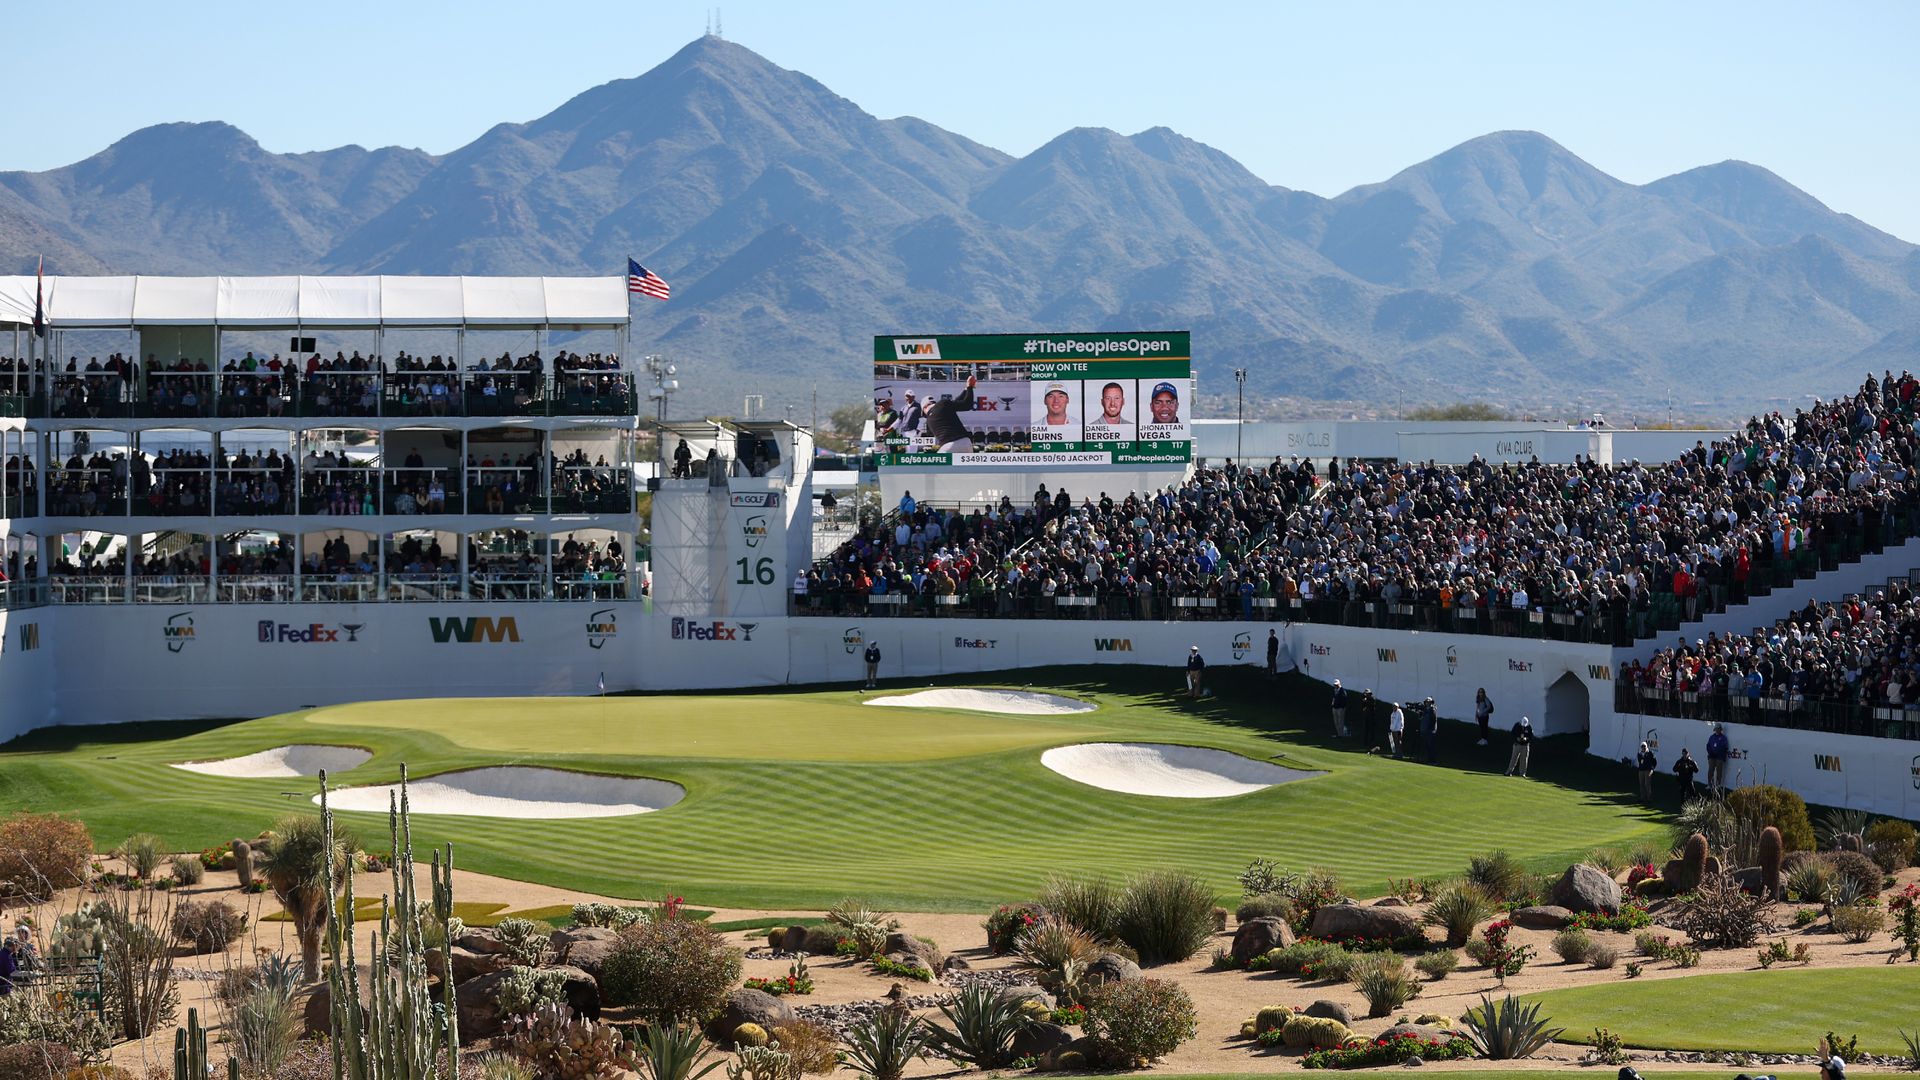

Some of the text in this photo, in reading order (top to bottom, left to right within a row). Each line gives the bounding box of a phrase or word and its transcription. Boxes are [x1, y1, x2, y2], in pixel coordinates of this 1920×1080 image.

[900, 343, 934, 354] WM
[1023, 338, 1171, 356] #ThePeoplesOpen
[1031, 362, 1088, 372] NOW ON TEE
[1032, 433, 1063, 441] BURNS
[1086, 432, 1121, 440] BERGER
[1140, 431, 1171, 440] VEGAS
[1496, 440, 1533, 456] KIVA CLUB
[900, 456, 922, 464] 50/50
[960, 454, 1104, 463] $34912 GUARANTEED 50/50 JACKPOT
[1117, 454, 1185, 462] #ThePeoplesOpen
[744, 495, 764, 504] GOLF
[743, 526, 767, 535] WM
[736, 557, 775, 585] 16
[163, 626, 196, 637] WM
[278, 623, 338, 643] FedEx
[428, 616, 521, 643] WM
[586, 623, 617, 633] WM
[687, 621, 737, 641] FedEx
[963, 638, 988, 648] FedEx
[1094, 638, 1133, 651] WM
[1231, 641, 1251, 649] WM
[1376, 647, 1397, 663] WM
[1588, 664, 1611, 680] WM
[1814, 753, 1841, 772] WM
[1911, 766, 1920, 775] W
